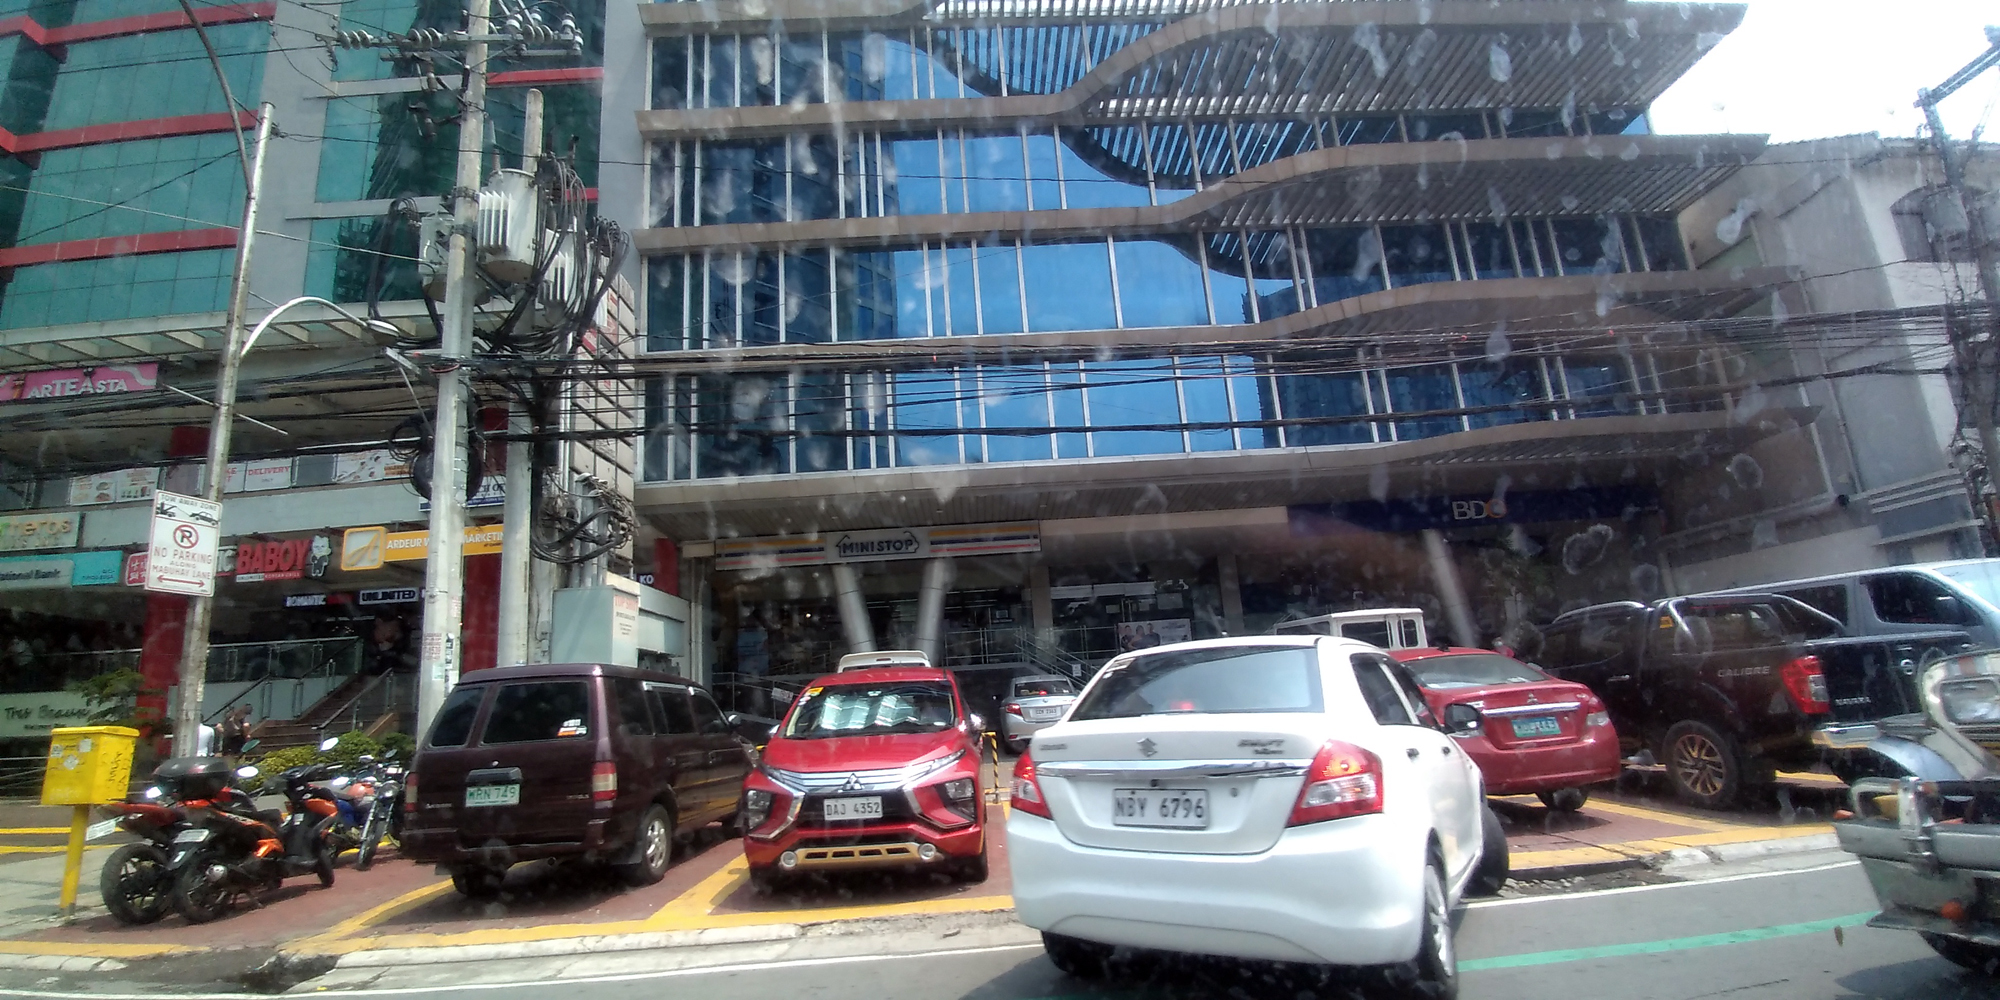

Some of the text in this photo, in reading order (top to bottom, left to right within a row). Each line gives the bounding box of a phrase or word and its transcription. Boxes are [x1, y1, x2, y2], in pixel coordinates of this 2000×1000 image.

[27, 378, 129, 398] ARTEASTA
[248, 466, 290, 476] DELIVERY
[161, 494, 217, 511] TOW AWAY ZONE
[387, 538, 422, 550] ARDEUR
[464, 531, 504, 544] MARKETIN
[842, 539, 914, 554] MINISTOP
[154, 546, 168, 558] NO
[173, 549, 212, 564] PARKING
[236, 539, 311, 574] BABOY
[152, 564, 189, 576] MABUHAY
[192, 569, 211, 580] LANE
[169, 560, 196, 569] ALONG
[362, 590, 416, 602] UNLIMITED
[1717, 666, 1771, 678] CALIBRE
[494, 786, 516, 799] 749
[826, 801, 881, 816] DAJ 4352
[1115, 797, 1204, 818] NBY 6796
